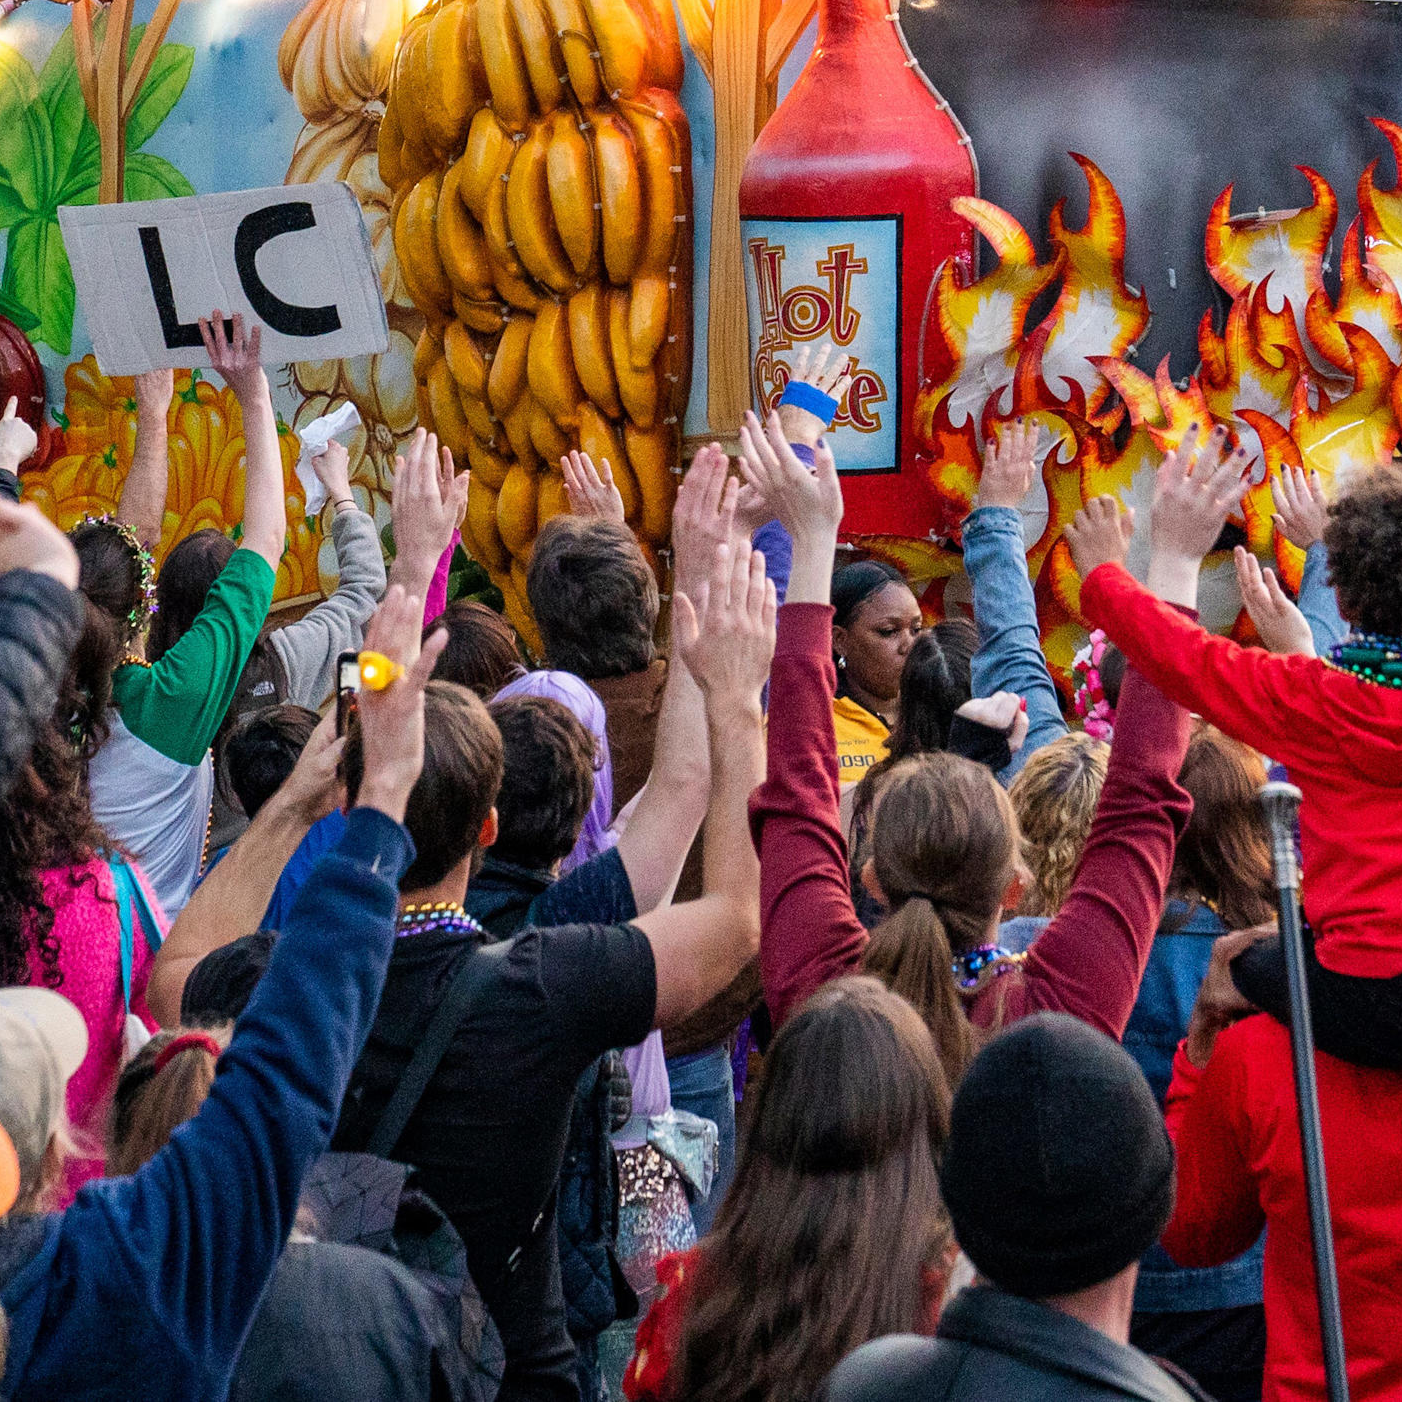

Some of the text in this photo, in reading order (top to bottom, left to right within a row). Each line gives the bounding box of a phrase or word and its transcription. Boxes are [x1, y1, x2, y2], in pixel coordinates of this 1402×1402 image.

[138, 201, 342, 349] LC
[749, 237, 868, 350] Hot
[755, 348, 887, 434] Sae
[837, 754, 875, 768] 090
